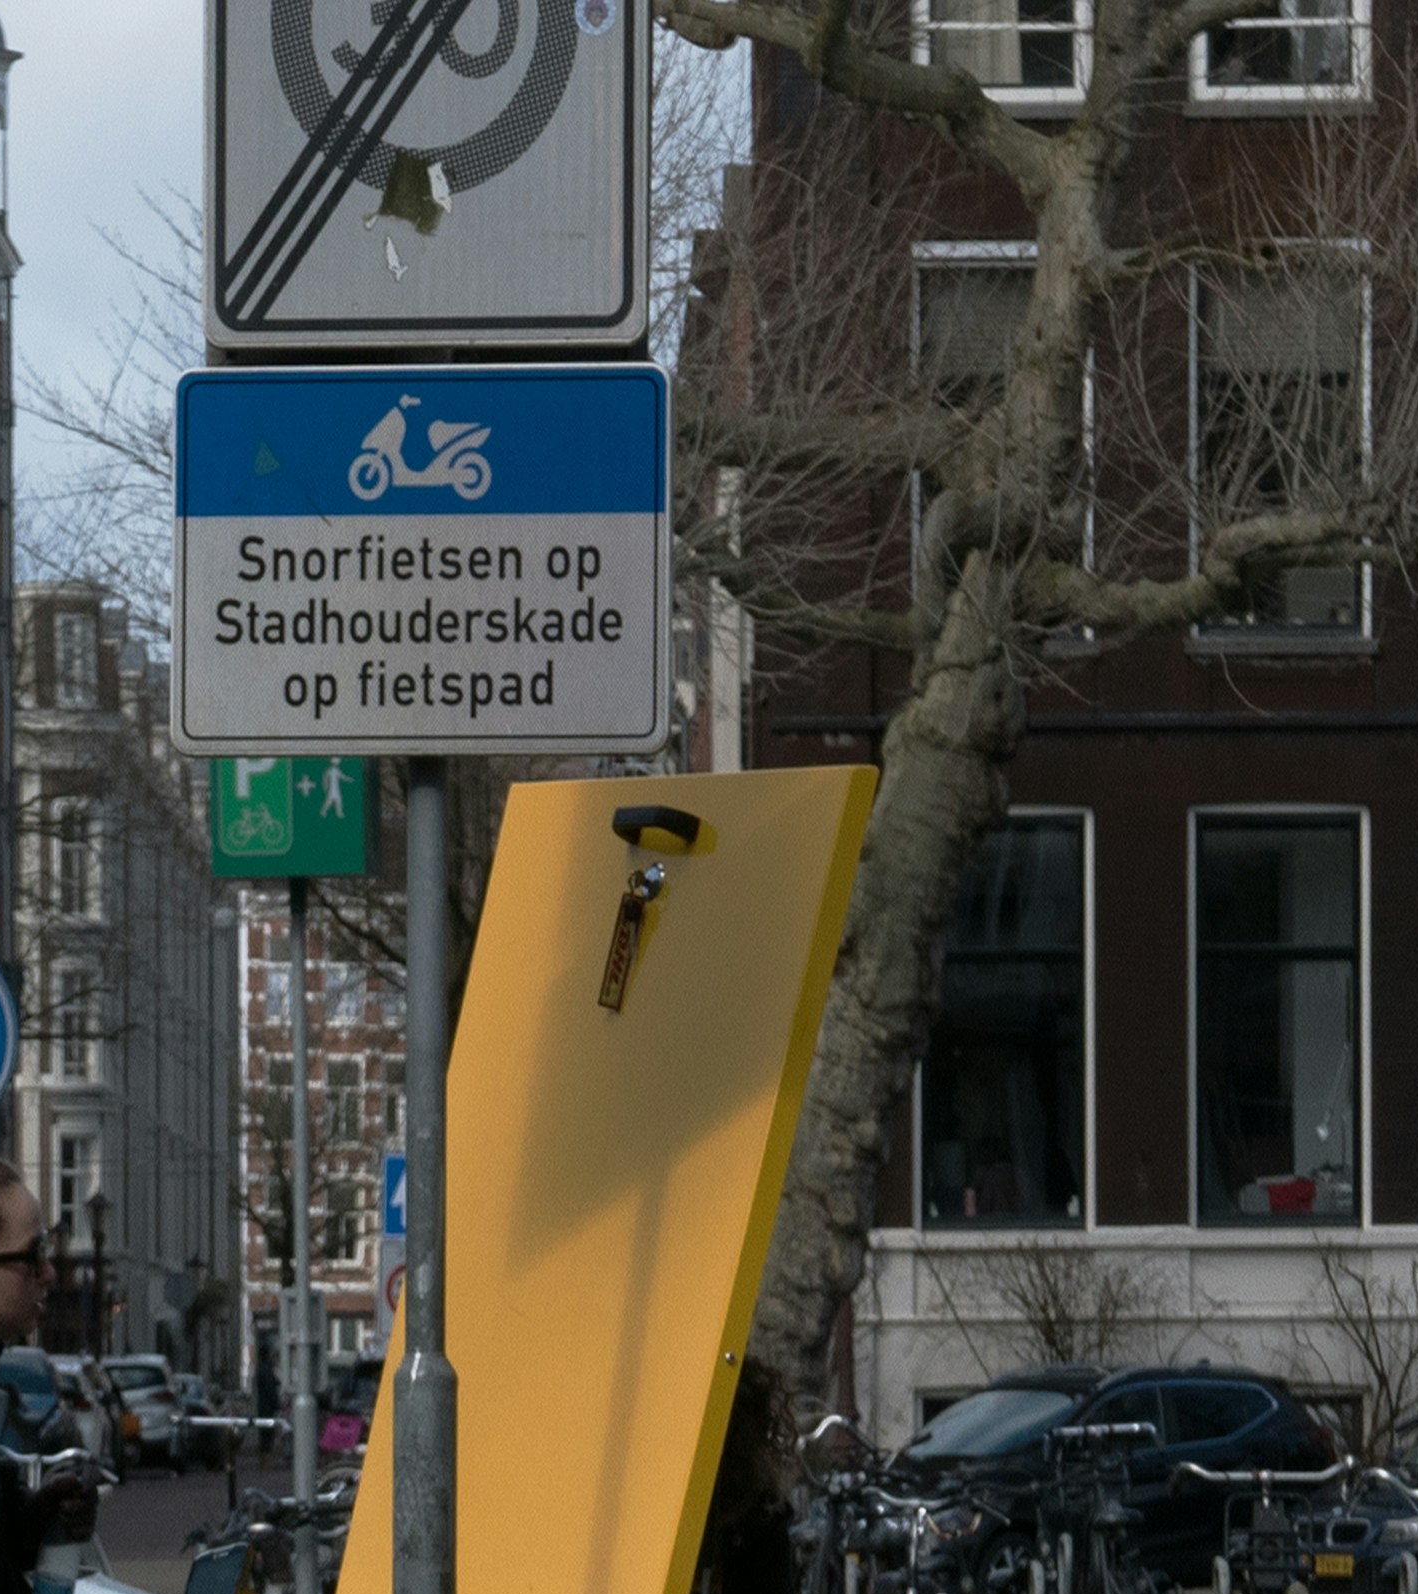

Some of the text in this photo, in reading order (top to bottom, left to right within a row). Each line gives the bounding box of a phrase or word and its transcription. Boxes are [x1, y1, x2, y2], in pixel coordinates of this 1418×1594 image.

[238, 537, 601, 591] Snorfietsen op
[215, 599, 623, 645] Stadhouderskade
[284, 661, 554, 718] op fietspad
